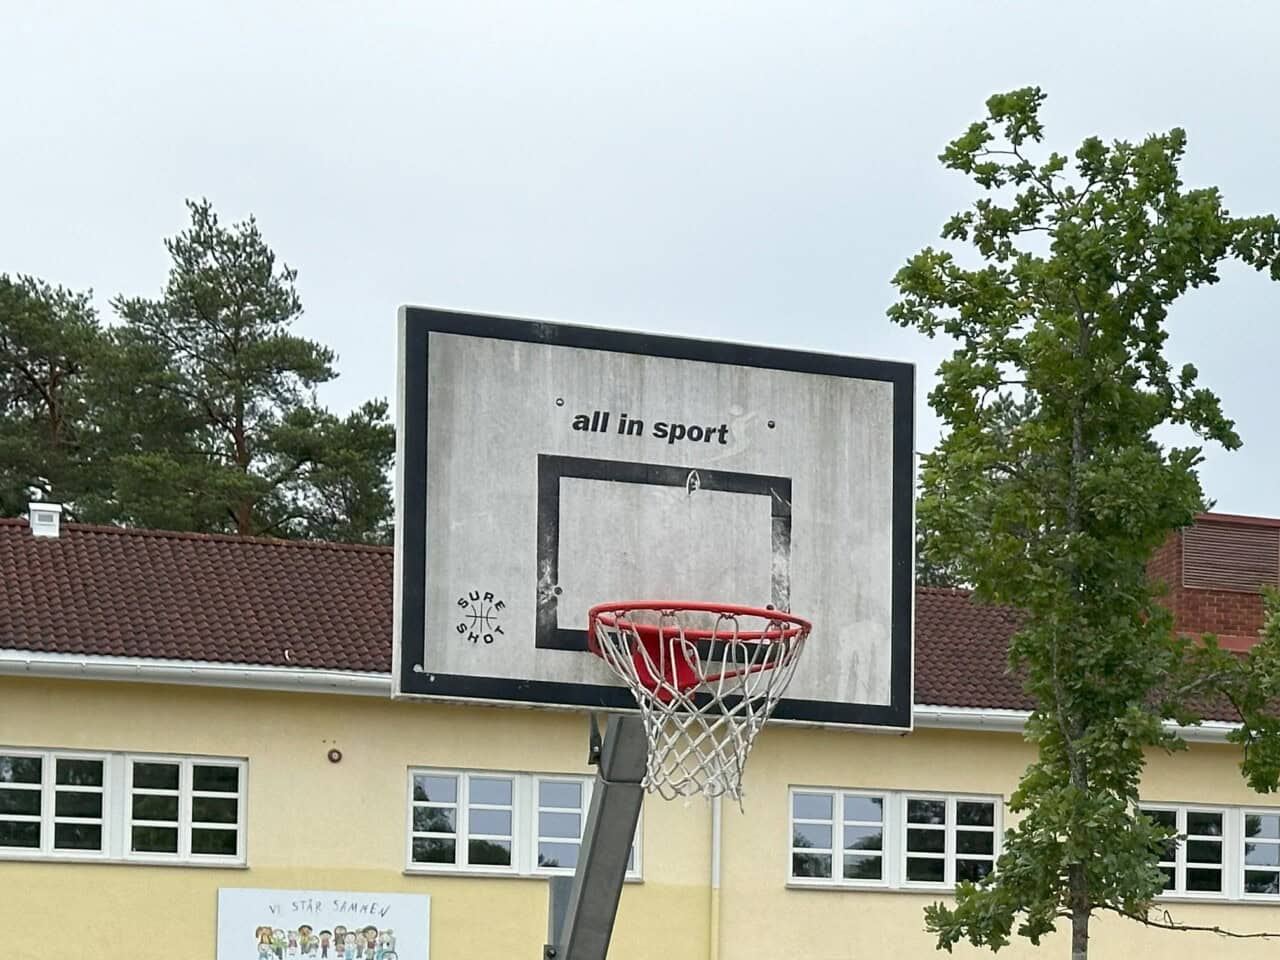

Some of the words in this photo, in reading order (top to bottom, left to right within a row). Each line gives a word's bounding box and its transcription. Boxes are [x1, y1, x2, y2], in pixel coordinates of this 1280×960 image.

[572, 411, 610, 433] all
[618, 413, 644, 436] in
[652, 421, 729, 444] sport
[457, 590, 506, 612] SURE
[456, 623, 505, 644] SHOT
[291, 898, 323, 913] STÅR
[333, 899, 391, 918] SAMMEN
